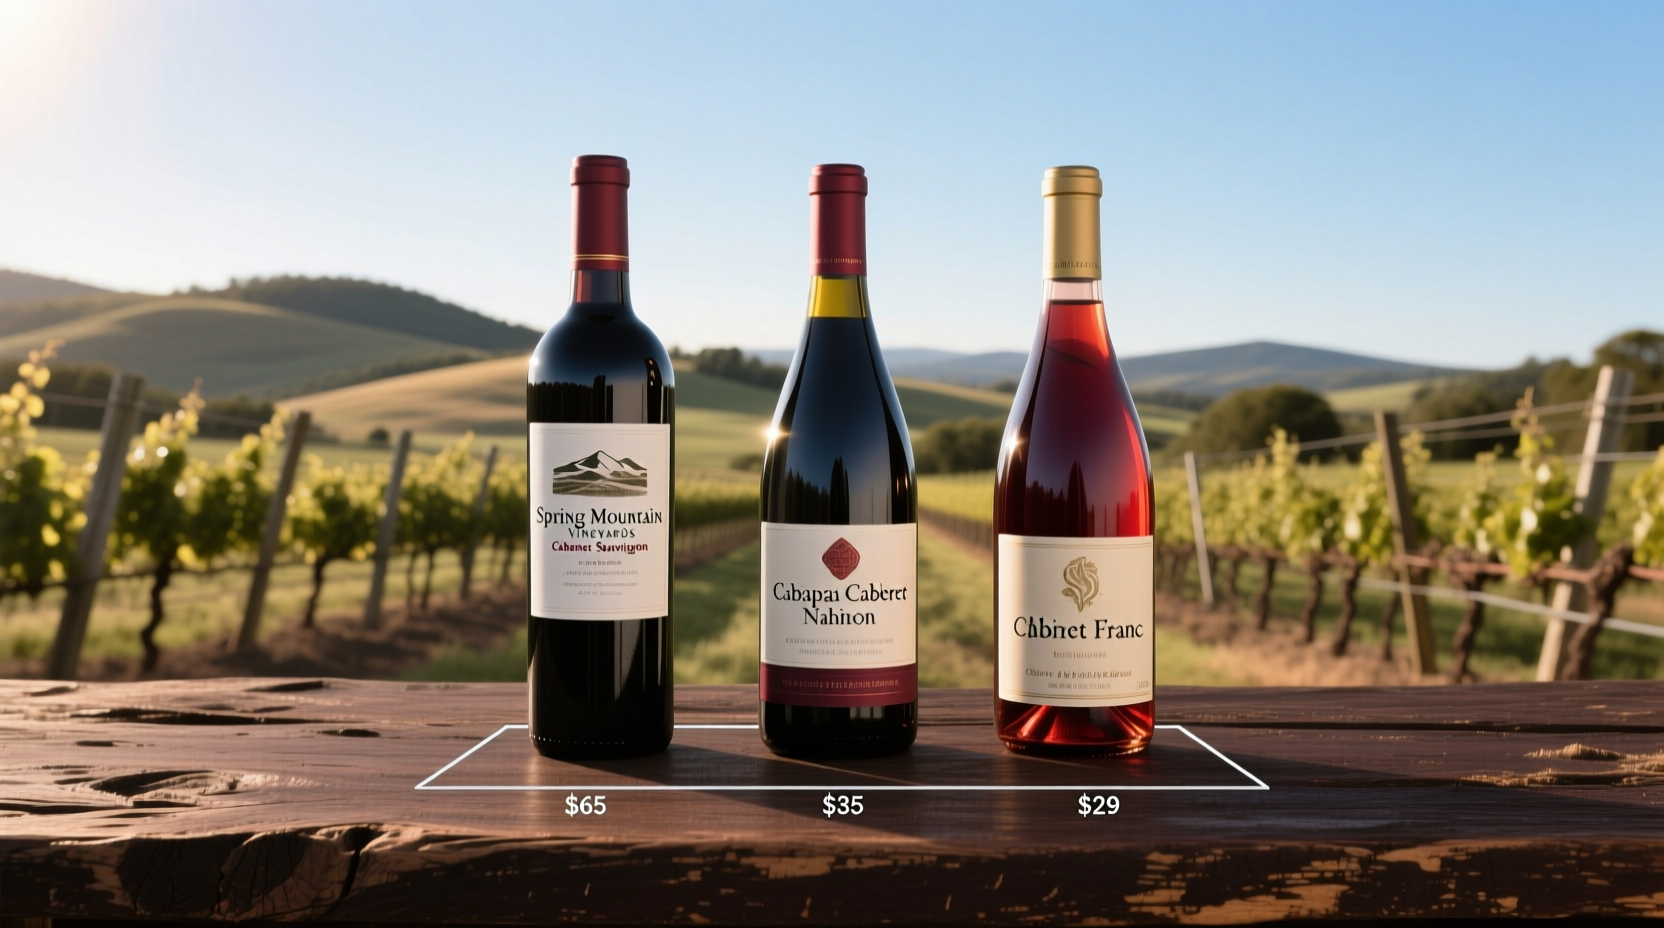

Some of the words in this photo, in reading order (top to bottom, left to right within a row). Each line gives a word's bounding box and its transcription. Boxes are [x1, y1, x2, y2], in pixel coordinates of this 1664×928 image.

[536, 506, 586, 529] Spring
[591, 508, 662, 525] Mountain
[1094, 619, 1144, 639] Franc
